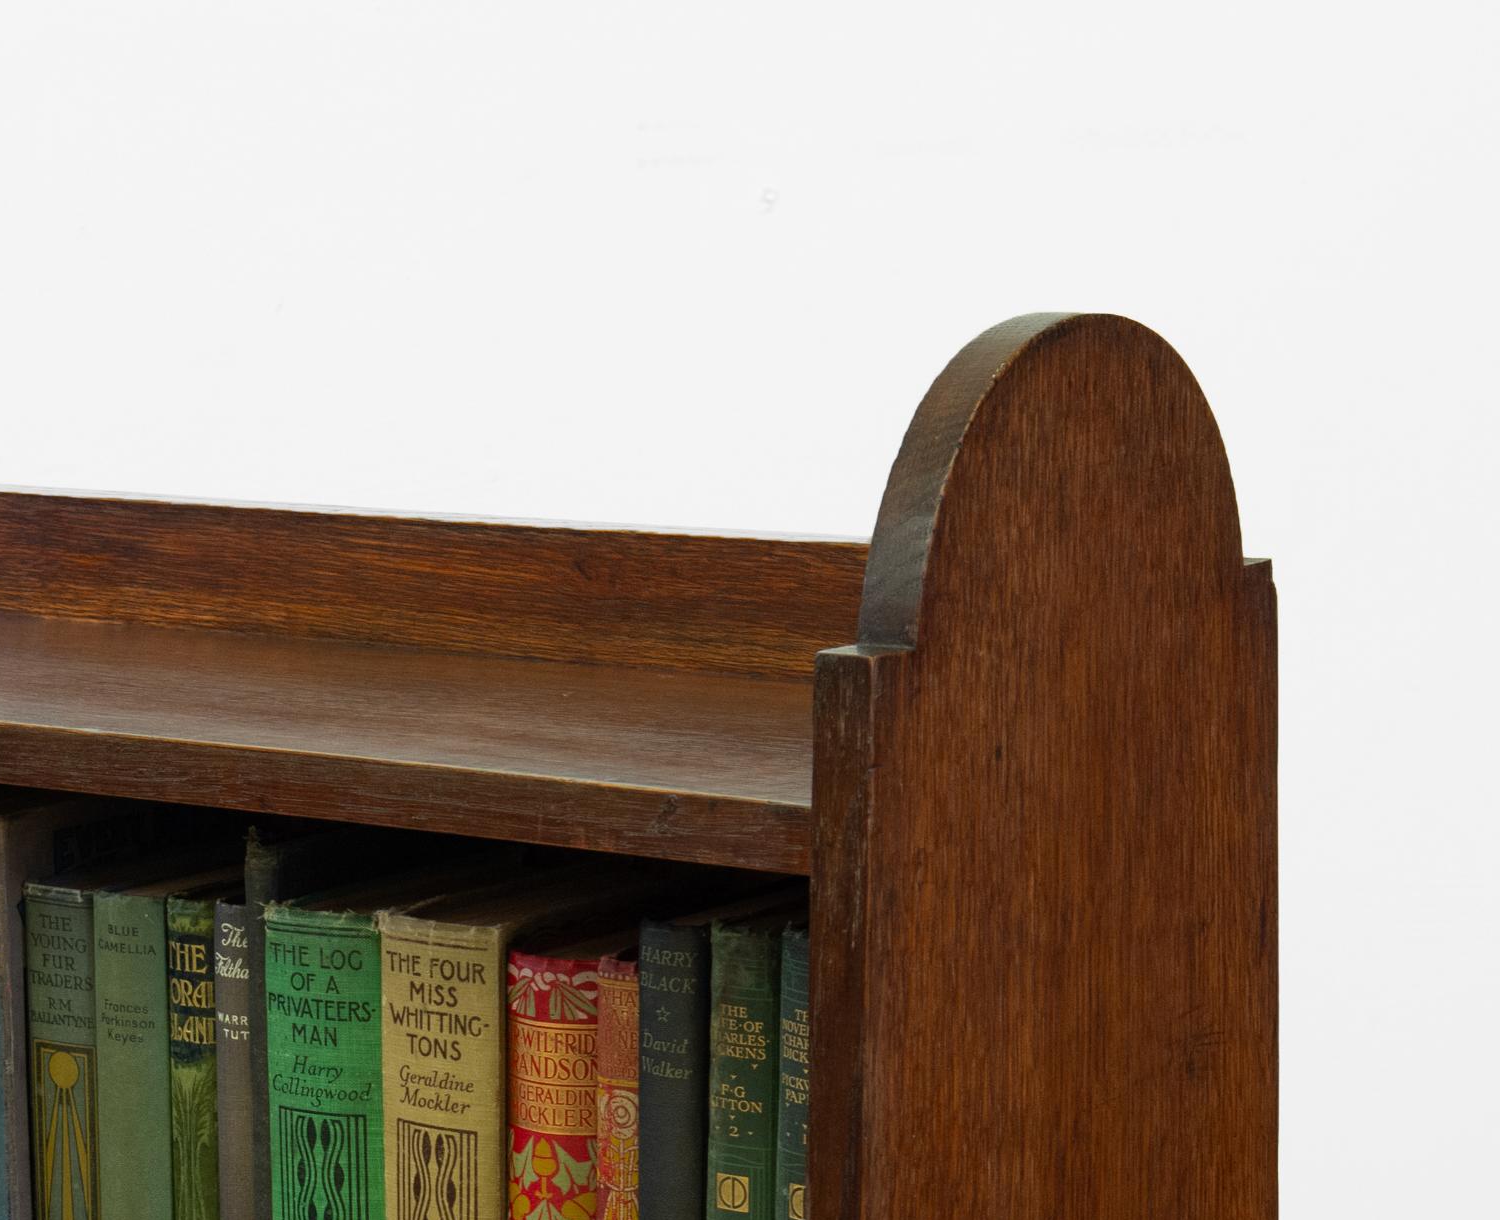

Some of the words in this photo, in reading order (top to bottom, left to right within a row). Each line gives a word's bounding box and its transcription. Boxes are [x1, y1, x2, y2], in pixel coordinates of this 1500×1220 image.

[38, 913, 73, 932] THE
[107, 924, 139, 937] BLUE
[30, 932, 87, 953] YOUNG
[221, 922, 248, 948] The
[98, 938, 157, 956] CAMELLIA
[168, 941, 208, 974] THE
[269, 942, 309, 967] THE
[320, 947, 363, 971] LOG
[640, 945, 700, 968] HARRY
[42, 953, 76, 971] FUR
[215, 951, 250, 979] Feltha
[386, 950, 422, 977] THE
[429, 957, 486, 985] FOUR
[29, 969, 94, 991] TRADERS
[291, 972, 316, 992] OF
[326, 975, 340, 994] A
[640, 971, 698, 994] BLACK
[170, 978, 215, 1009] ORAL
[410, 980, 458, 1008] MISS
[104, 998, 149, 1014] Frances
[268, 992, 376, 1022] PRIVATEERS-
[719, 1003, 748, 1018] THE
[32, 1010, 95, 1030] BALLANTYNE
[101, 1012, 155, 1029] Parkinson
[217, 1011, 248, 1026] WARR
[389, 1002, 490, 1037] WHITTING-
[107, 1029, 144, 1046] Keyes
[223, 1028, 250, 1041] TUT
[292, 1023, 338, 1047] MAN
[643, 1032, 690, 1055] David
[406, 1033, 462, 1061] TONS
[783, 1048, 809, 1064] DICK
[293, 1055, 343, 1083] Harry
[399, 1064, 475, 1093] Geraldine
[642, 1055, 693, 1080] Walker
[273, 1073, 373, 1107] Collingwood
[400, 1086, 471, 1115] Mockler
[518, 1082, 596, 1106] GERALDIN
[785, 1088, 806, 1105] PAP
[728, 1126, 740, 1137] 2
